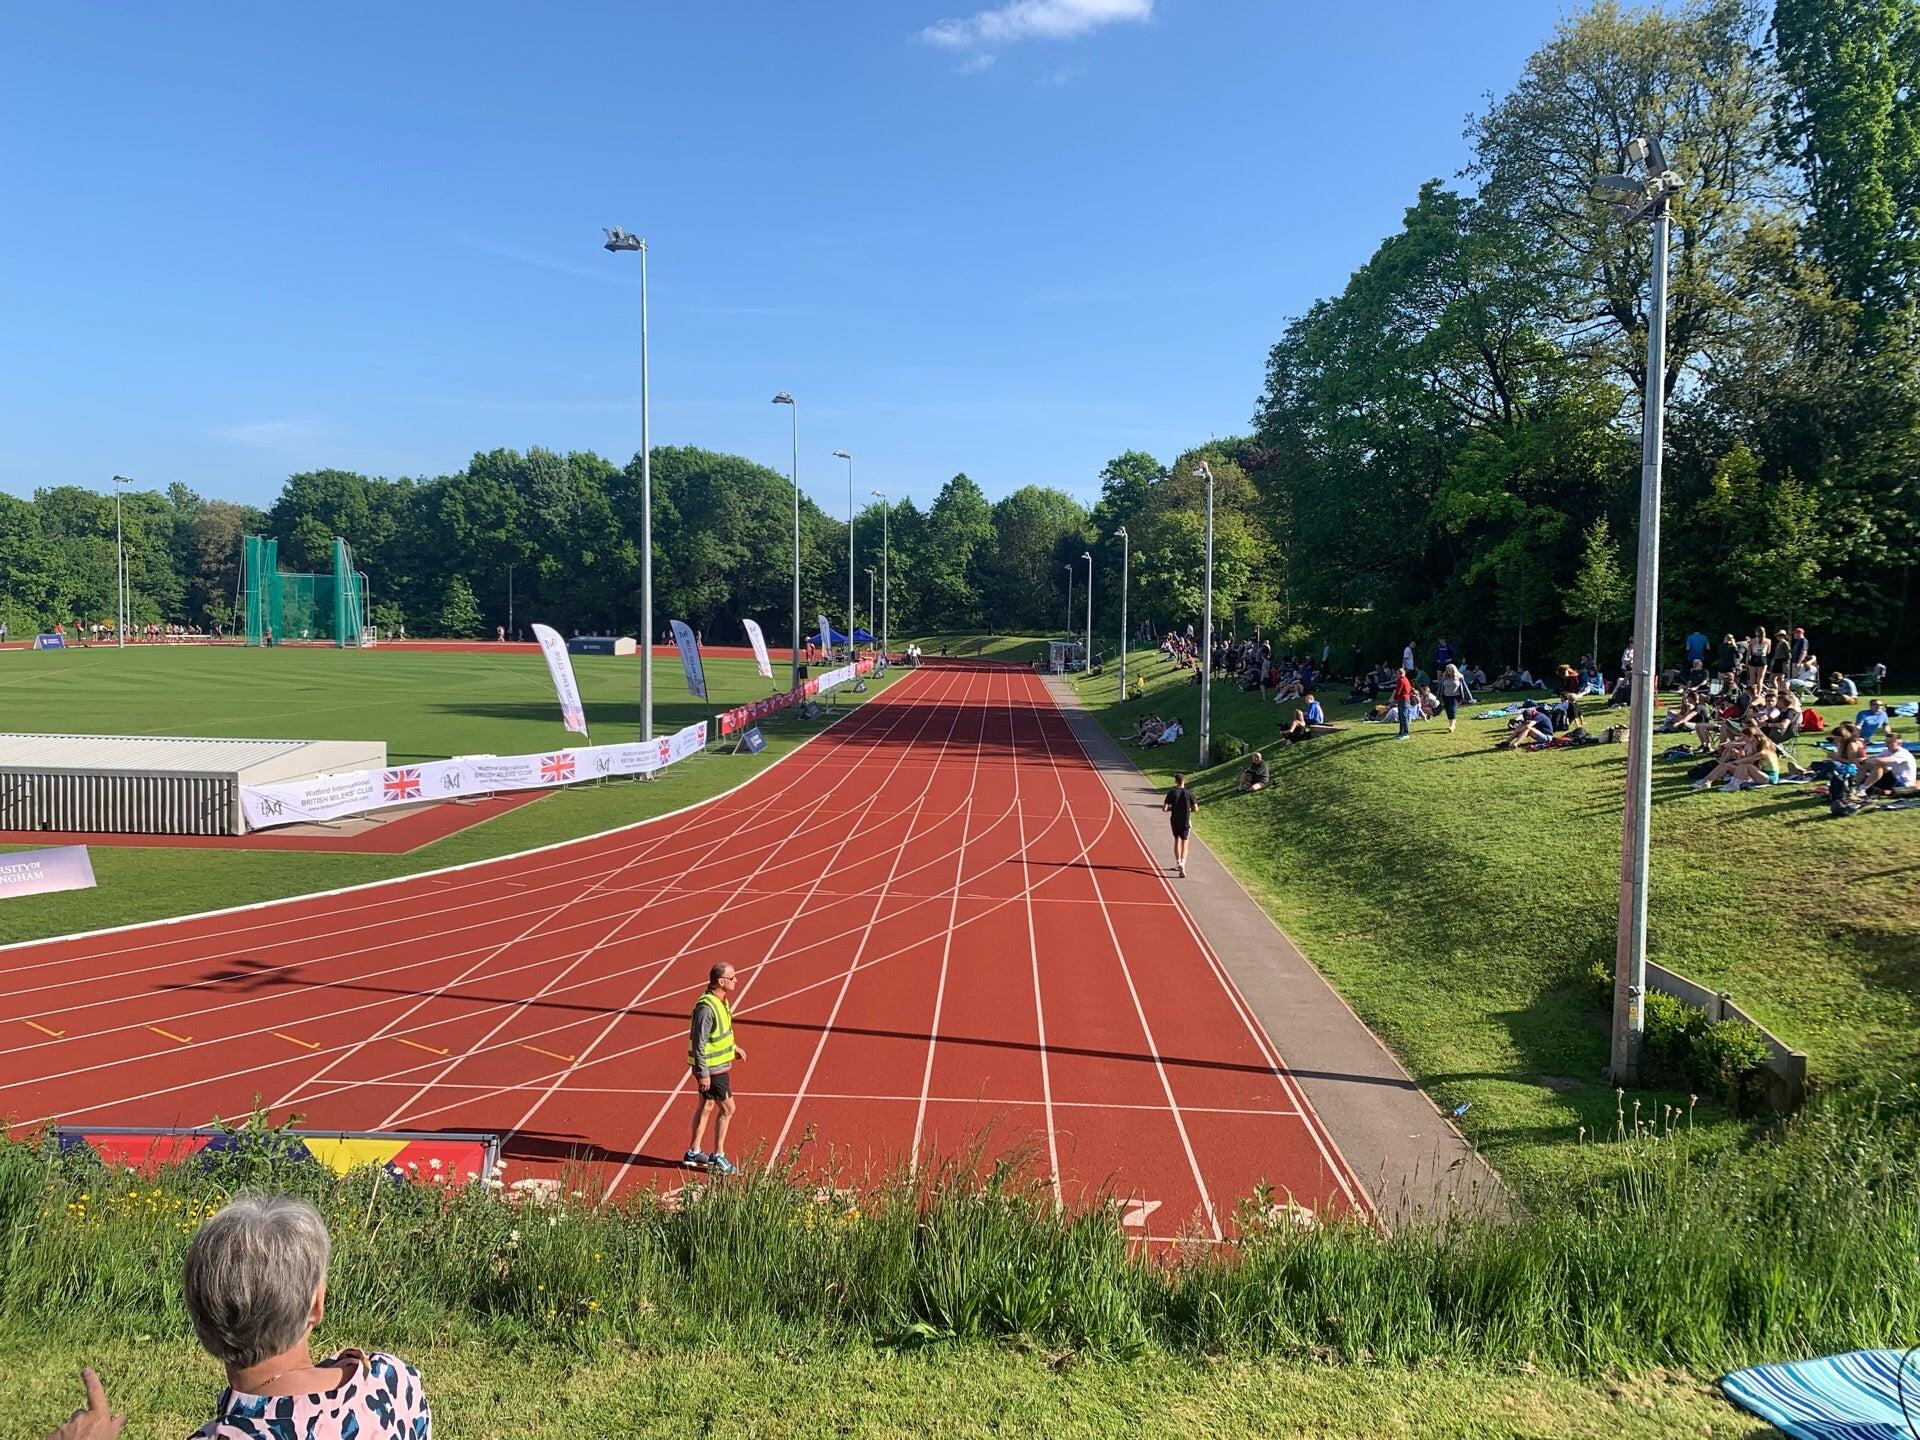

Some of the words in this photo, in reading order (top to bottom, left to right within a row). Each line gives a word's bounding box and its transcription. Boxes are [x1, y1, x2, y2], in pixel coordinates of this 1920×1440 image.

[301, 795, 329, 806] BRITISH
[357, 786, 374, 796] CLUB
[305, 788, 331, 798] Watford
